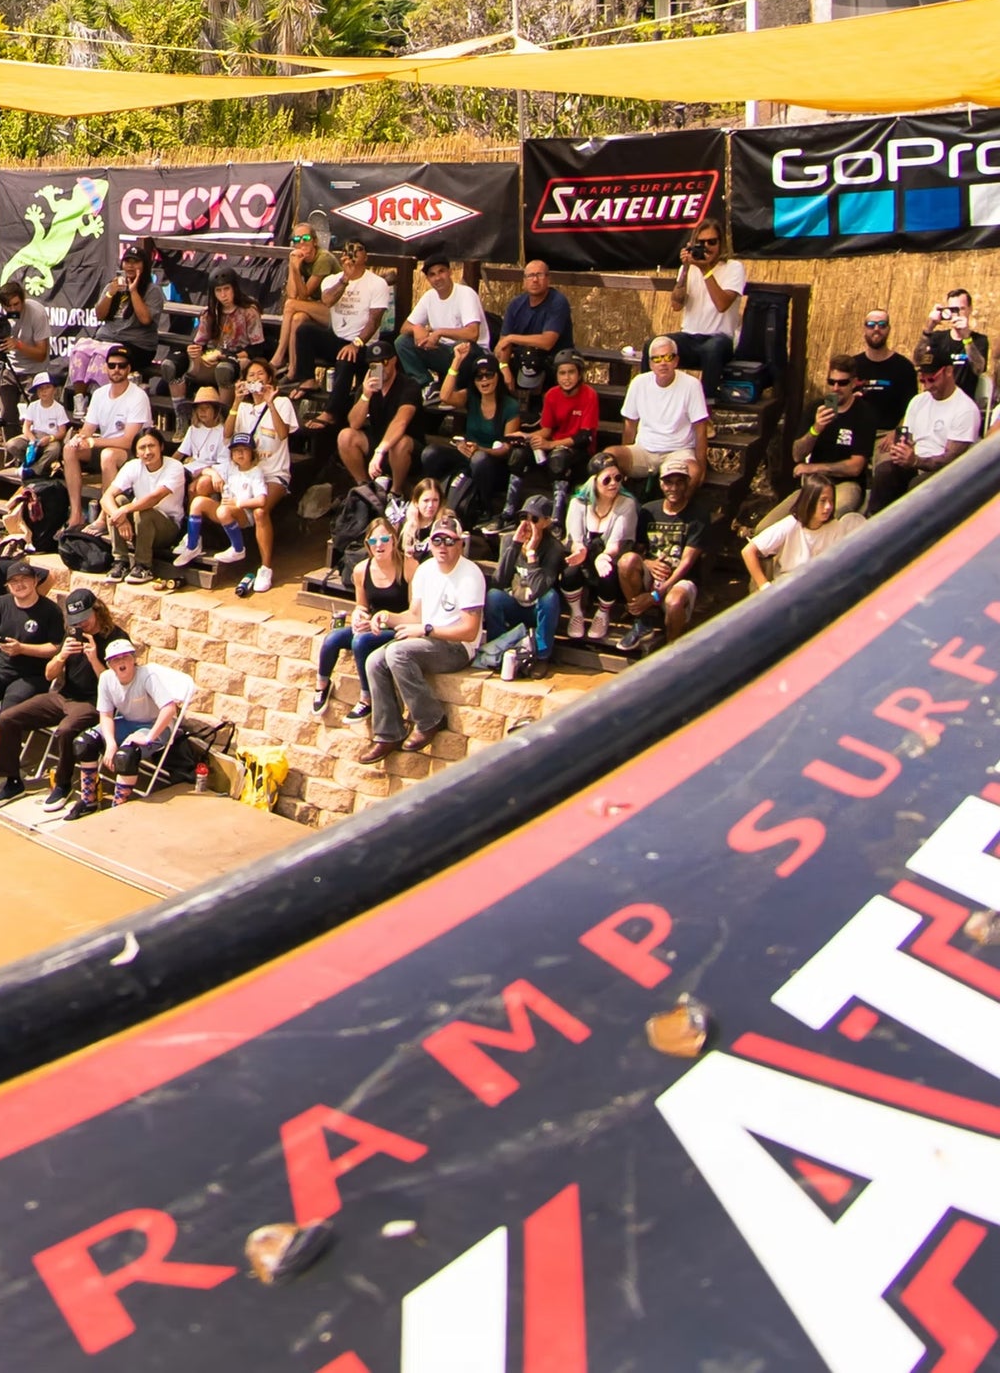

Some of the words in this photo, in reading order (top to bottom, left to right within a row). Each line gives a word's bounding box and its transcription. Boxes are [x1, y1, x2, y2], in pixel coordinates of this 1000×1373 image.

[120, 183, 277, 232] GECKO
[541, 186, 703, 224] SKATELITE
[578, 184, 624, 195] RAMP
[629, 180, 706, 194] SURFACE
[31, 902, 679, 1356] RAMP
[727, 600, 1000, 879] SURF
